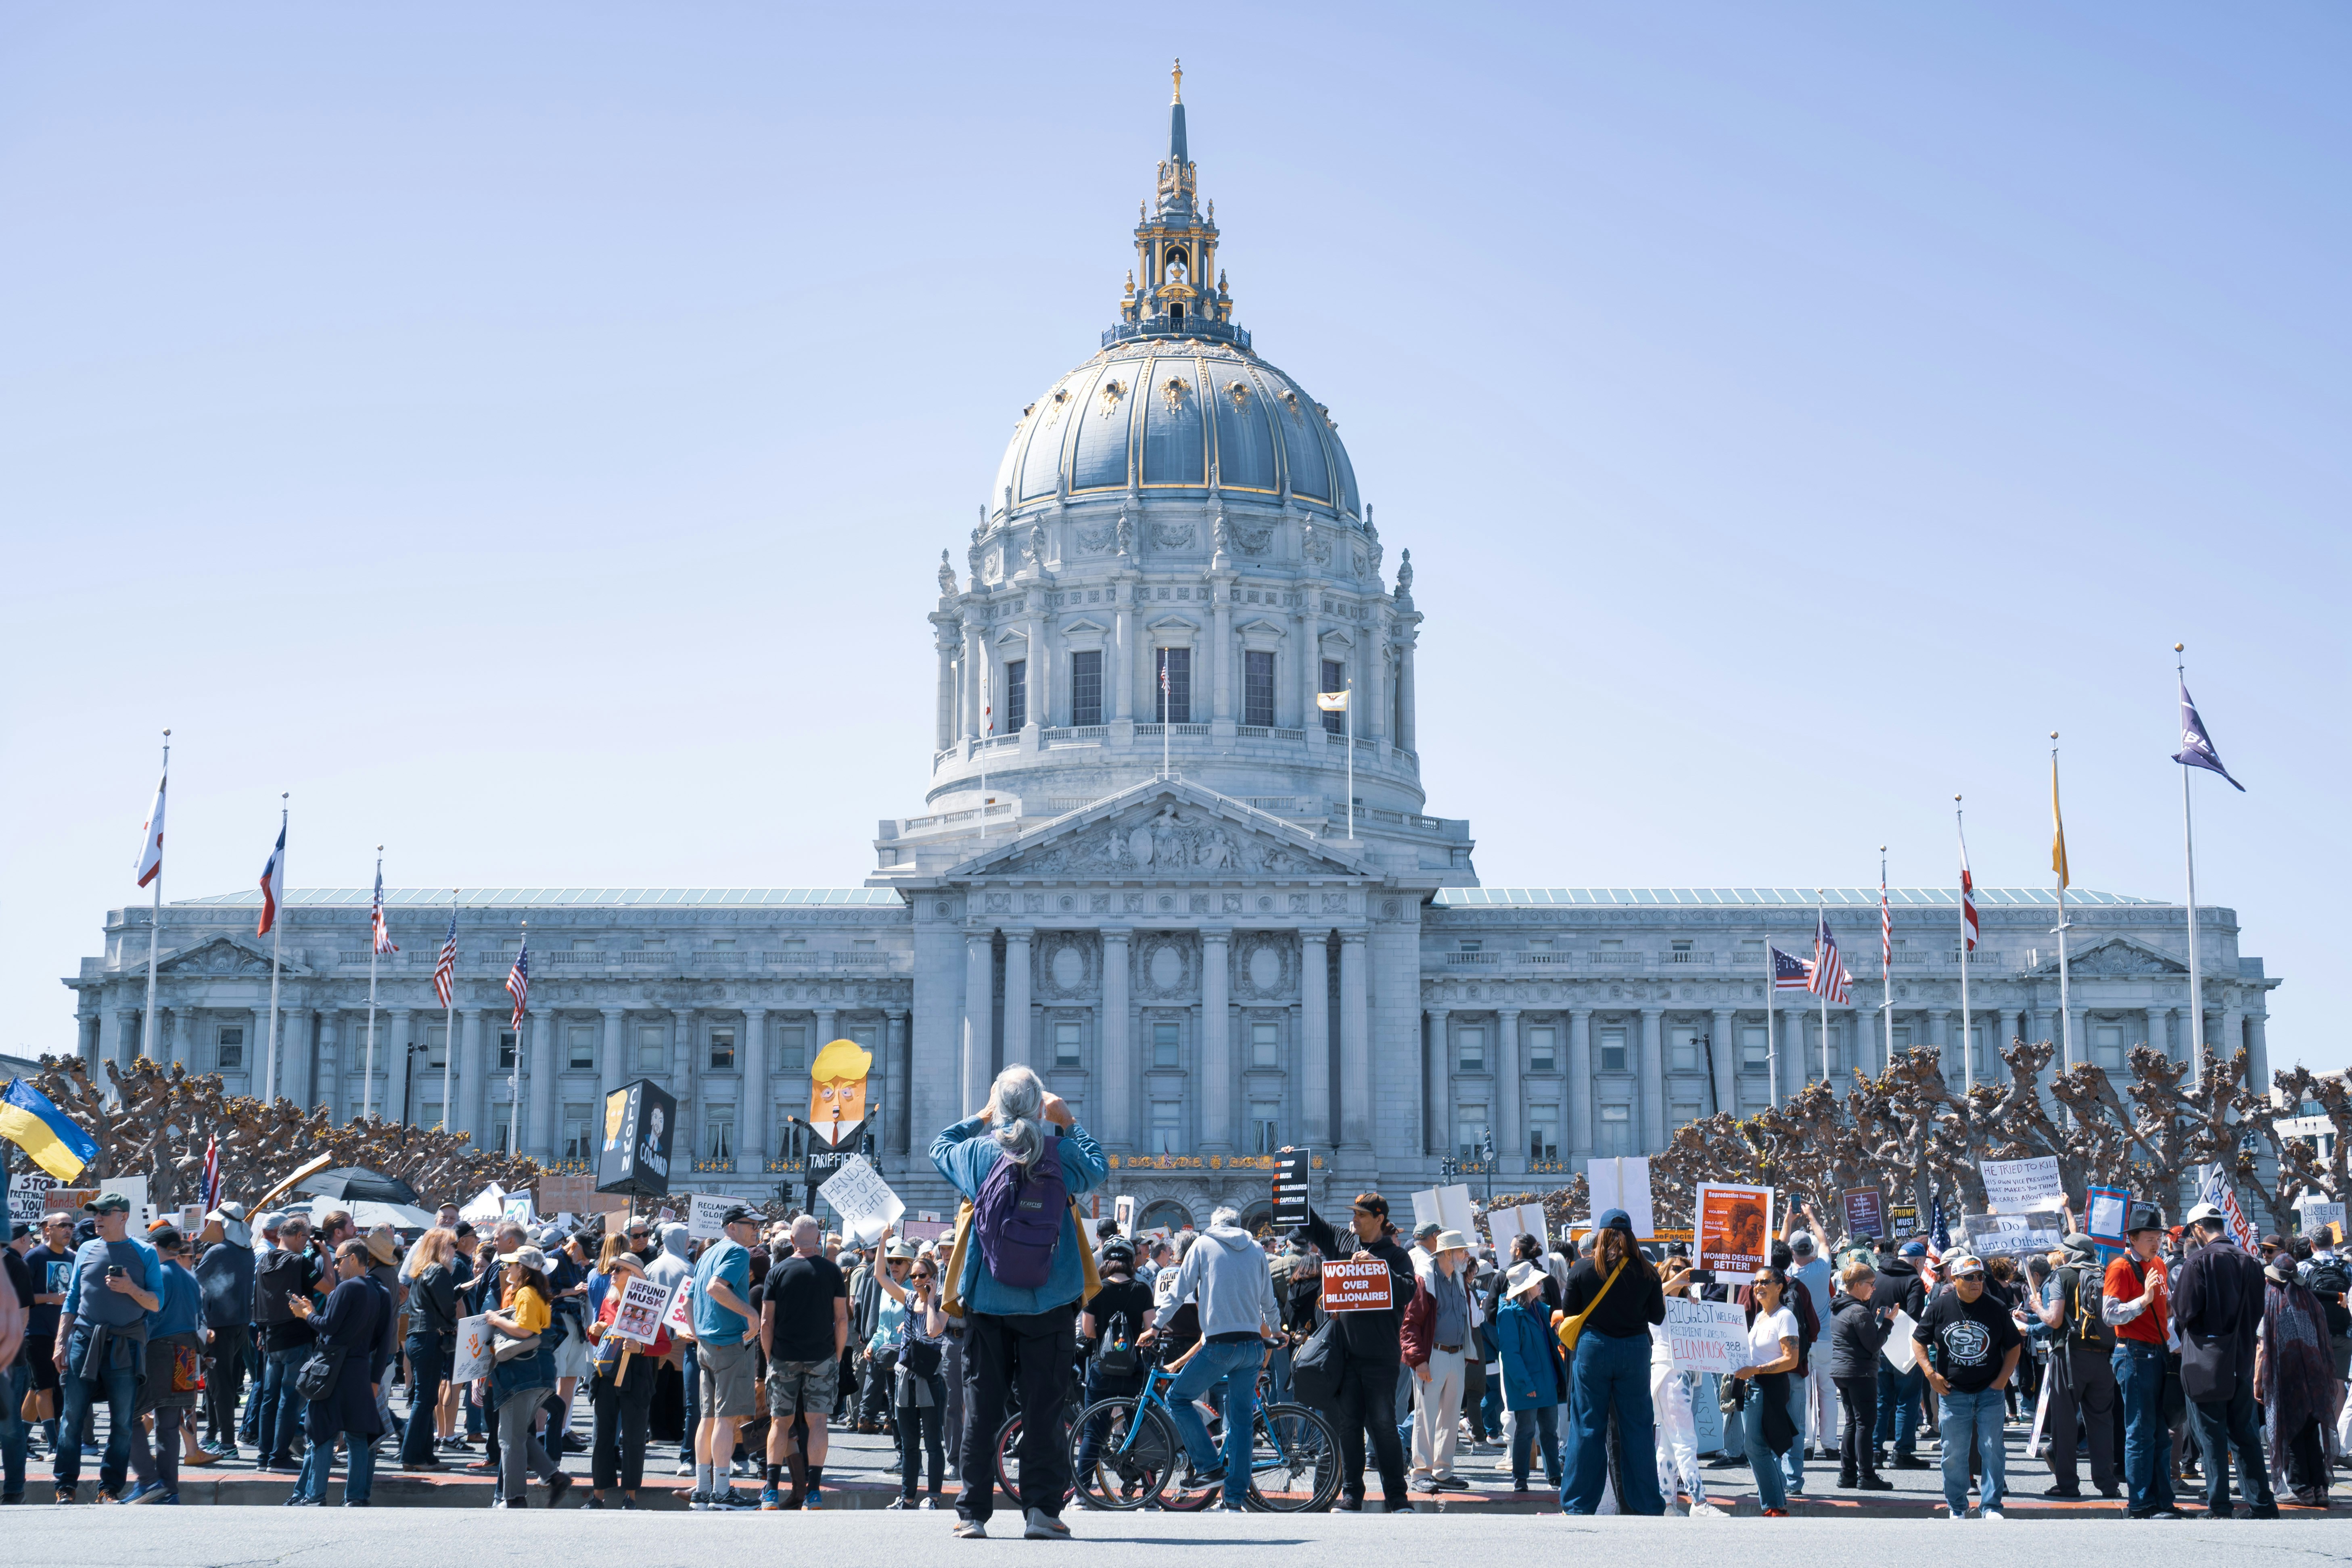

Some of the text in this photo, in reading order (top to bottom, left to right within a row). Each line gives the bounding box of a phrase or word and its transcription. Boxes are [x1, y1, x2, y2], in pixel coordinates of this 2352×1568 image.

[621, 1087, 638, 1172] CLOWN
[640, 1142, 667, 1177] COWARD
[1984, 1160, 2058, 1176] HE TRIED TO KILL
[21, 1177, 58, 1190] STOP
[822, 1159, 867, 1200] HANDS
[2026, 1173, 2059, 1183] PRESIDENT
[835, 1171, 882, 1212] OFF OUR
[2038, 1181, 2059, 1190] THINK
[45, 1192, 75, 1209] Hands
[1990, 1195, 1999, 1203] HE
[2021, 1192, 2043, 1202] ABOUT
[2045, 1190, 2061, 1198] YOU?
[698, 1201, 732, 1210] RECLAIM
[847, 1184, 891, 1224] RIGHTS
[1020, 1200, 1042, 1208] trans
[9, 1210, 40, 1219] RACISM
[1894, 1208, 1915, 1217] TRUMP
[2304, 1206, 2327, 1216] RISE
[1897, 1217, 1914, 1226] MUST
[2001, 1222, 2020, 1231] Do
[1896, 1227, 1909, 1237] GO!
[1981, 1241, 2008, 1250] unto
[1703, 1252, 1763, 1263] WOMEN DESERVE
[1324, 1263, 1387, 1278] WORKERS
[1714, 1261, 1750, 1271] BETTER!
[629, 1281, 666, 1298] DEFUND
[1160, 1280, 1174, 1292] OF
[1342, 1280, 1369, 1290] OVER
[627, 1291, 665, 1308] MUSK
[1326, 1291, 1388, 1303] BILLIONAIRES
[1667, 1300, 1744, 1325] BIGGEST WELFARE
[1670, 1325, 1702, 1337] RECIPIENT
[1941, 1321, 1960, 1335] PURO
[1952, 1328, 1983, 1355] SF
[1672, 1338, 1701, 1360] ELON
[1701, 1340, 1727, 1359] MUSK
[1947, 1351, 1988, 1366] NINERS
